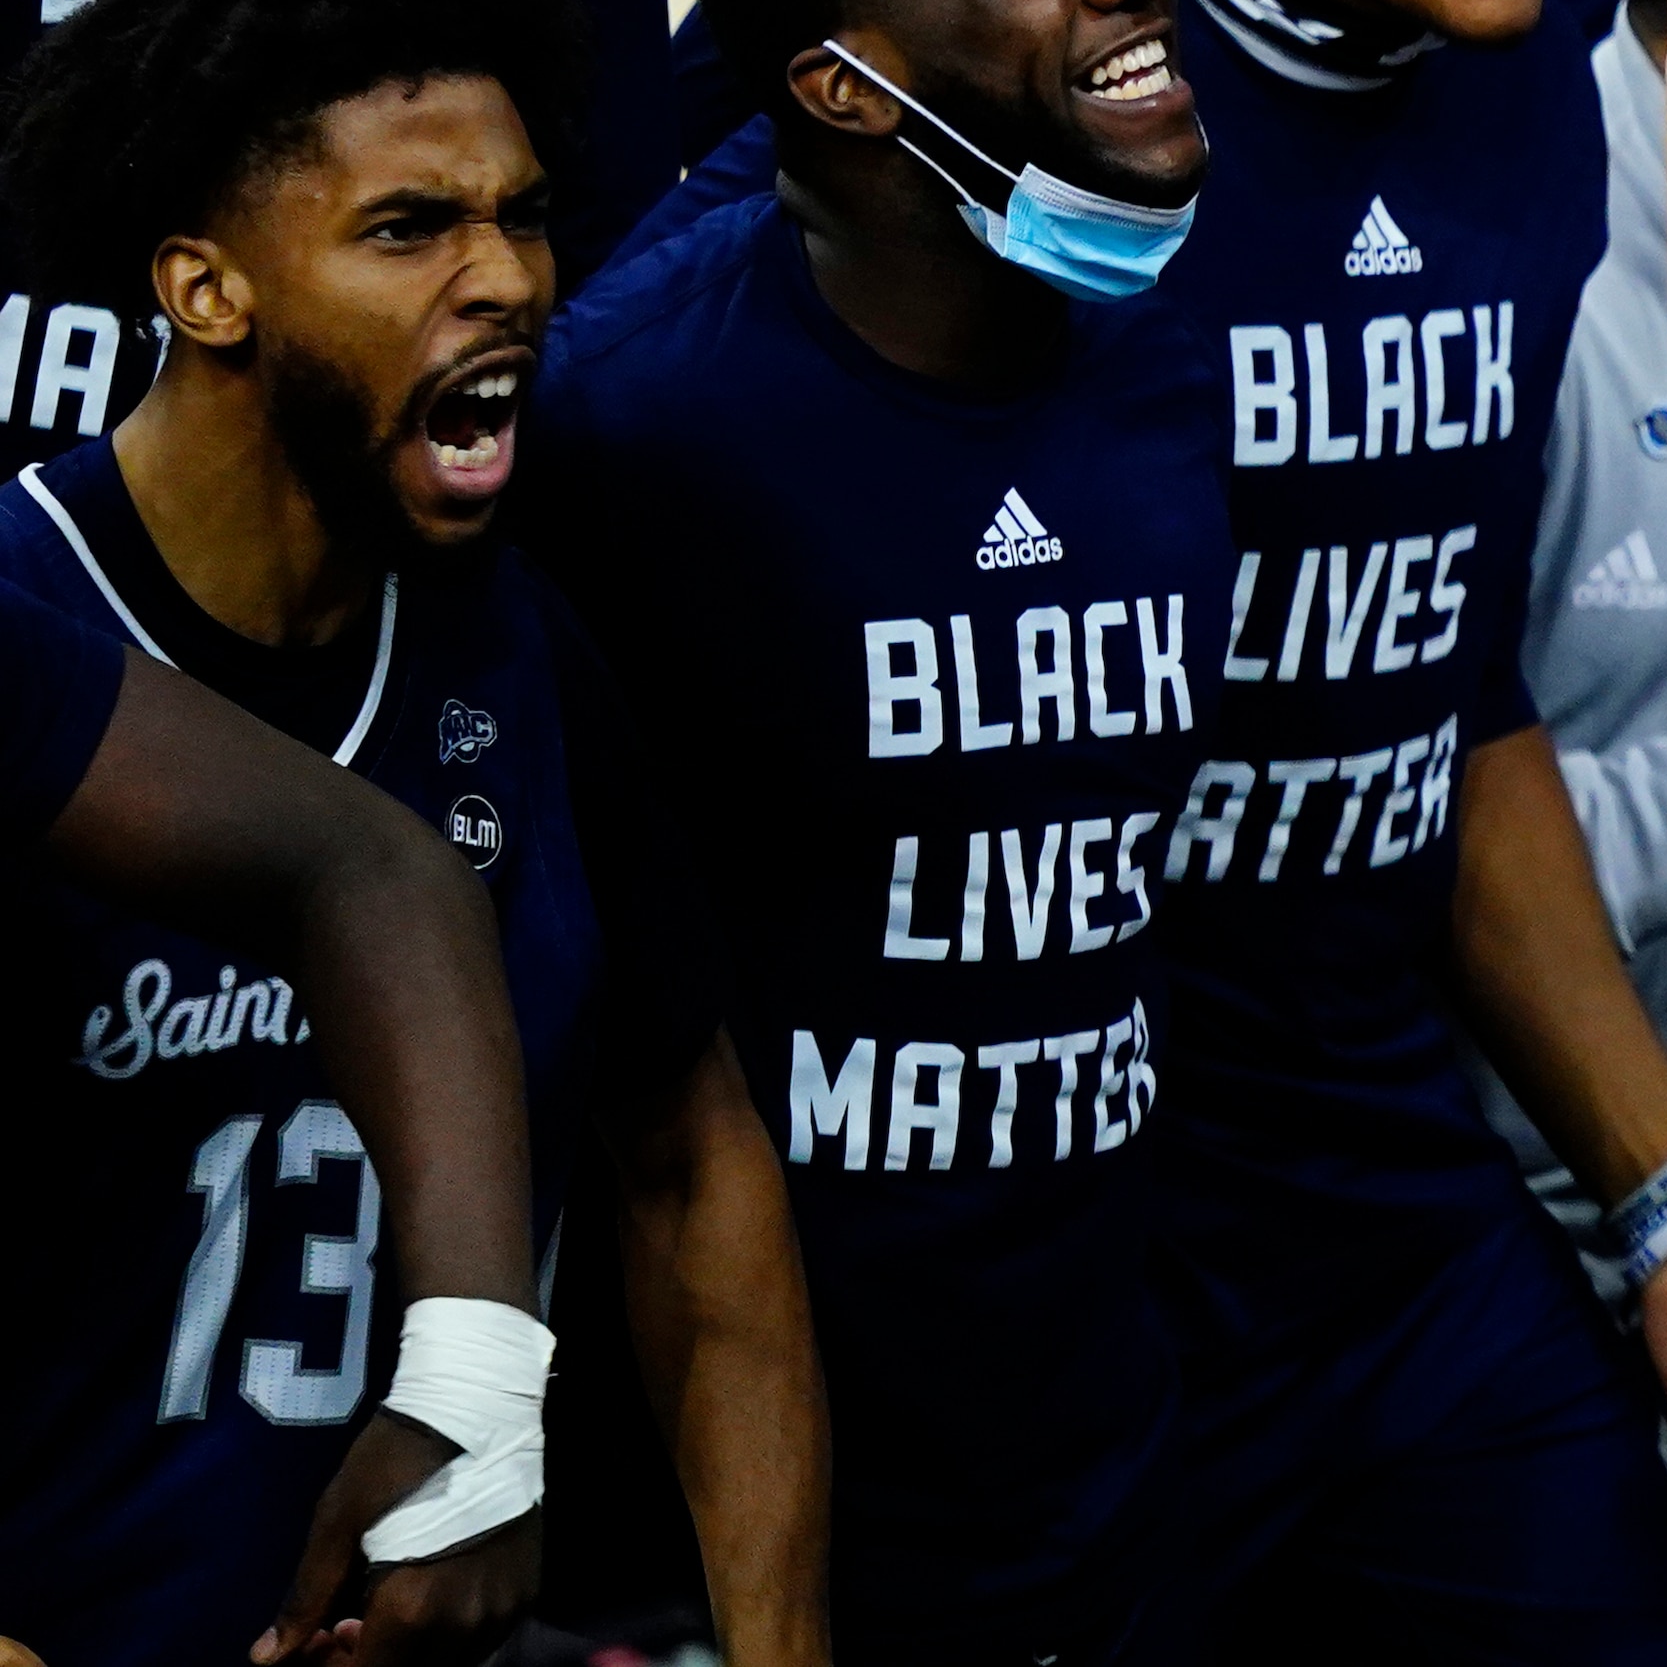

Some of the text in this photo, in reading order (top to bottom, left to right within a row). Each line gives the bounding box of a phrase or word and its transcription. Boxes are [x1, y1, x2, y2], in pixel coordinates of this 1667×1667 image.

[1344, 245, 1423, 276] adidas
[1230, 302, 1514, 466] BLACK
[976, 533, 1063, 570] adidas
[1224, 526, 1477, 681] LIVES
[864, 594, 1193, 758] BLACK
[453, 813, 496, 849] BLM
[1163, 712, 1457, 883] ATTER
[884, 812, 1160, 962] LIVES
[789, 997, 1157, 1171] MATTER
[157, 1098, 381, 1425] 13
